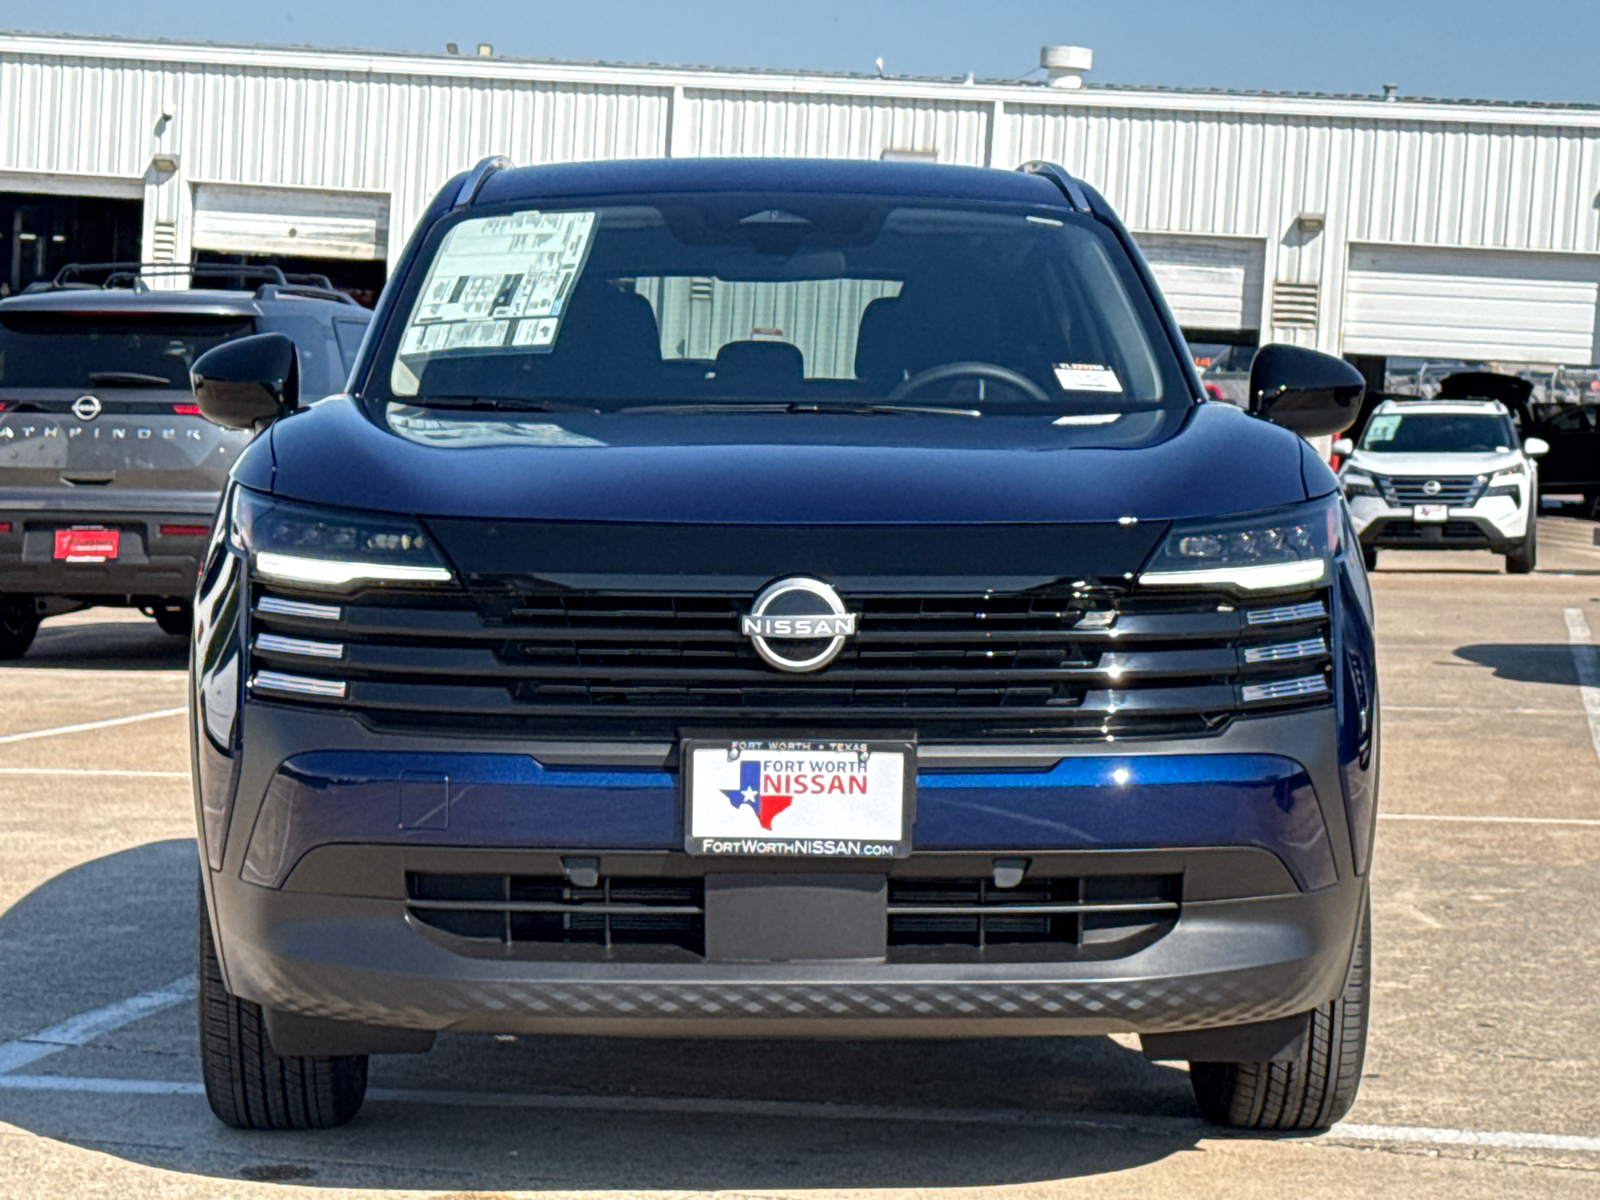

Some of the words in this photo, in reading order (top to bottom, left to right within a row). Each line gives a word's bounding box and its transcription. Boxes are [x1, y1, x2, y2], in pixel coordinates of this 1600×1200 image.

[744, 618, 852, 634] NISSAN
[731, 741, 762, 750] FORT
[768, 741, 811, 751] WORTH
[829, 743, 868, 752] TEXAS
[763, 760, 805, 773] FORT
[809, 760, 867, 773] WORTH
[763, 774, 867, 795] NISSAN
